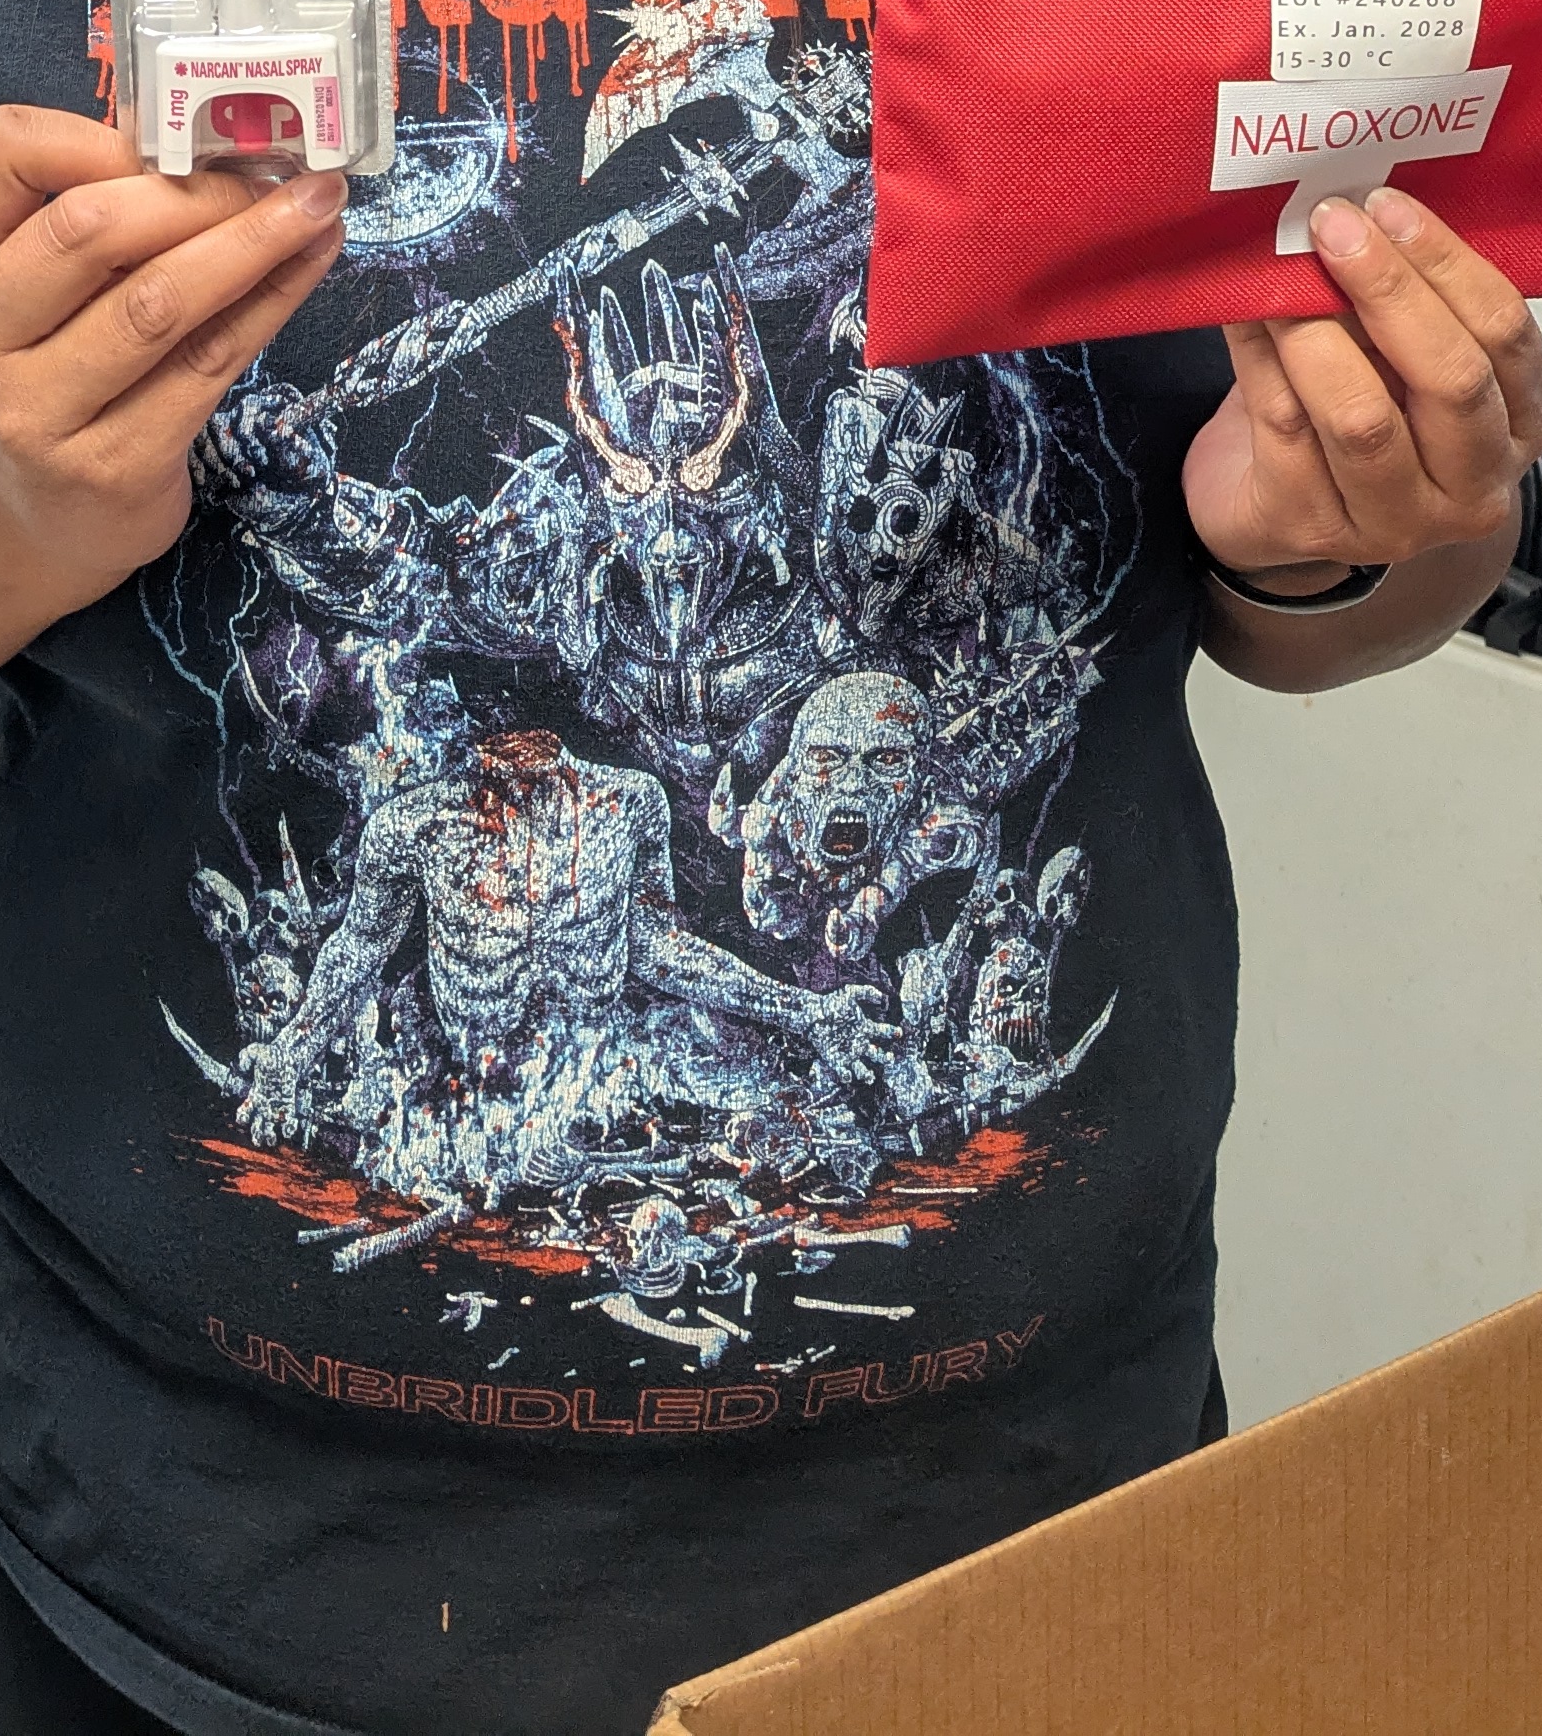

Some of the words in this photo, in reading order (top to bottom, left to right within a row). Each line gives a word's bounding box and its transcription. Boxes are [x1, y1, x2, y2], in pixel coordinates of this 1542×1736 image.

[1277, 20, 1317, 39] Ex.
[1330, 20, 1386, 39] Jan.
[1400, 20, 1465, 38] 2028
[245, 60, 285, 79] NASAL
[285, 57, 323, 78] SPRAY
[1275, 50, 1352, 69] 15-30
[1366, 49, 1394, 68] °C
[170, 89, 189, 117] mg
[314, 86, 325, 103] DIN
[167, 120, 186, 132] 4
[315, 104, 326, 143] 02458187
[1230, 94, 1485, 158] NALOXONE
[206, 1316, 782, 1435] UNBRIDLED
[803, 1313, 1045, 1418] FURY
